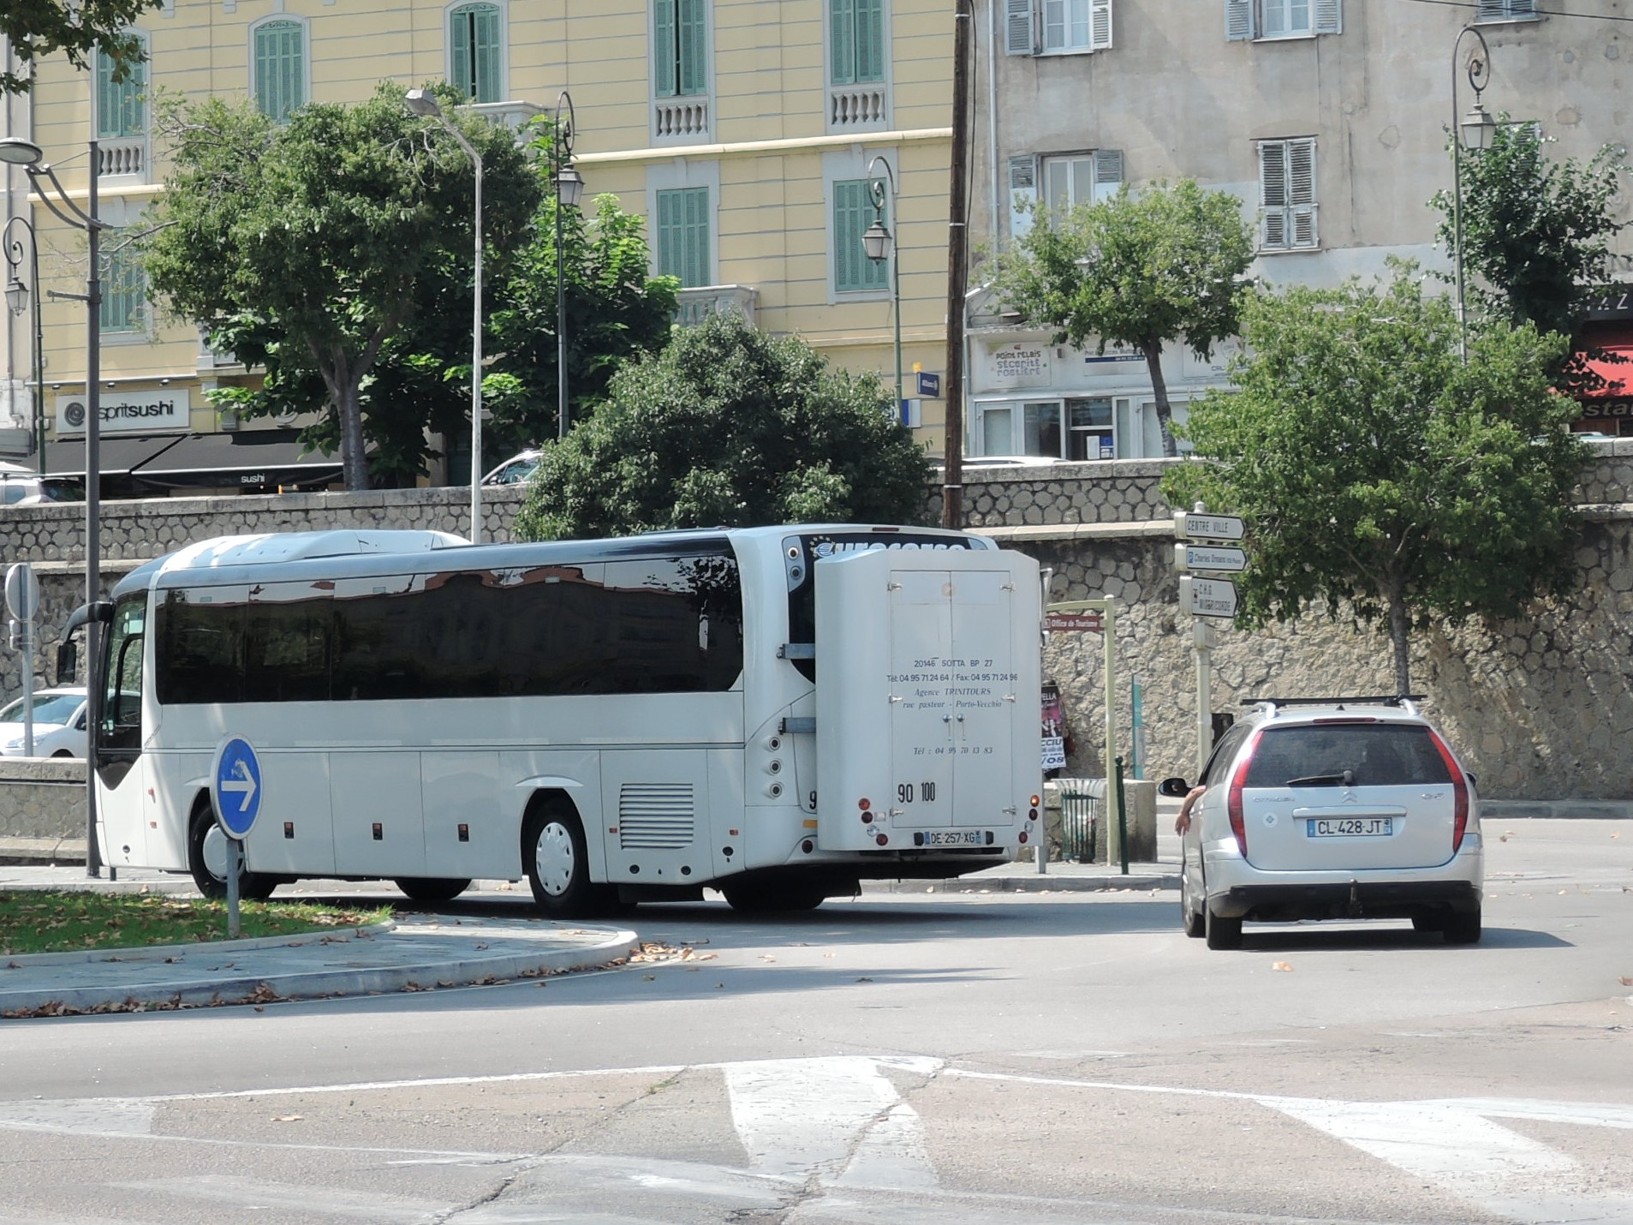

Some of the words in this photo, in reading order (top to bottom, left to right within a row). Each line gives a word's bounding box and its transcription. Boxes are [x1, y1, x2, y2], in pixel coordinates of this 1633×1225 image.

[98, 400, 174, 422] spritsushi
[240, 473, 265, 483] sushi
[1188, 520, 1210, 532] CENTRE
[1213, 522, 1229, 533] VILLE
[914, 659, 936, 668] 20146
[941, 659, 965, 667] SOTTA
[970, 659, 980, 667] BP
[984, 659, 993, 667] 27
[899, 674, 910, 682] 04
[910, 674, 921, 682] 95
[970, 673, 981, 681] 04
[981, 673, 991, 681] 95
[914, 688, 940, 698] Agence
[945, 687, 992, 696] TRINITOURS
[898, 783, 914, 803] 90
[921, 782, 936, 802] 100
[1317, 820, 1383, 835] CL-428-JT
